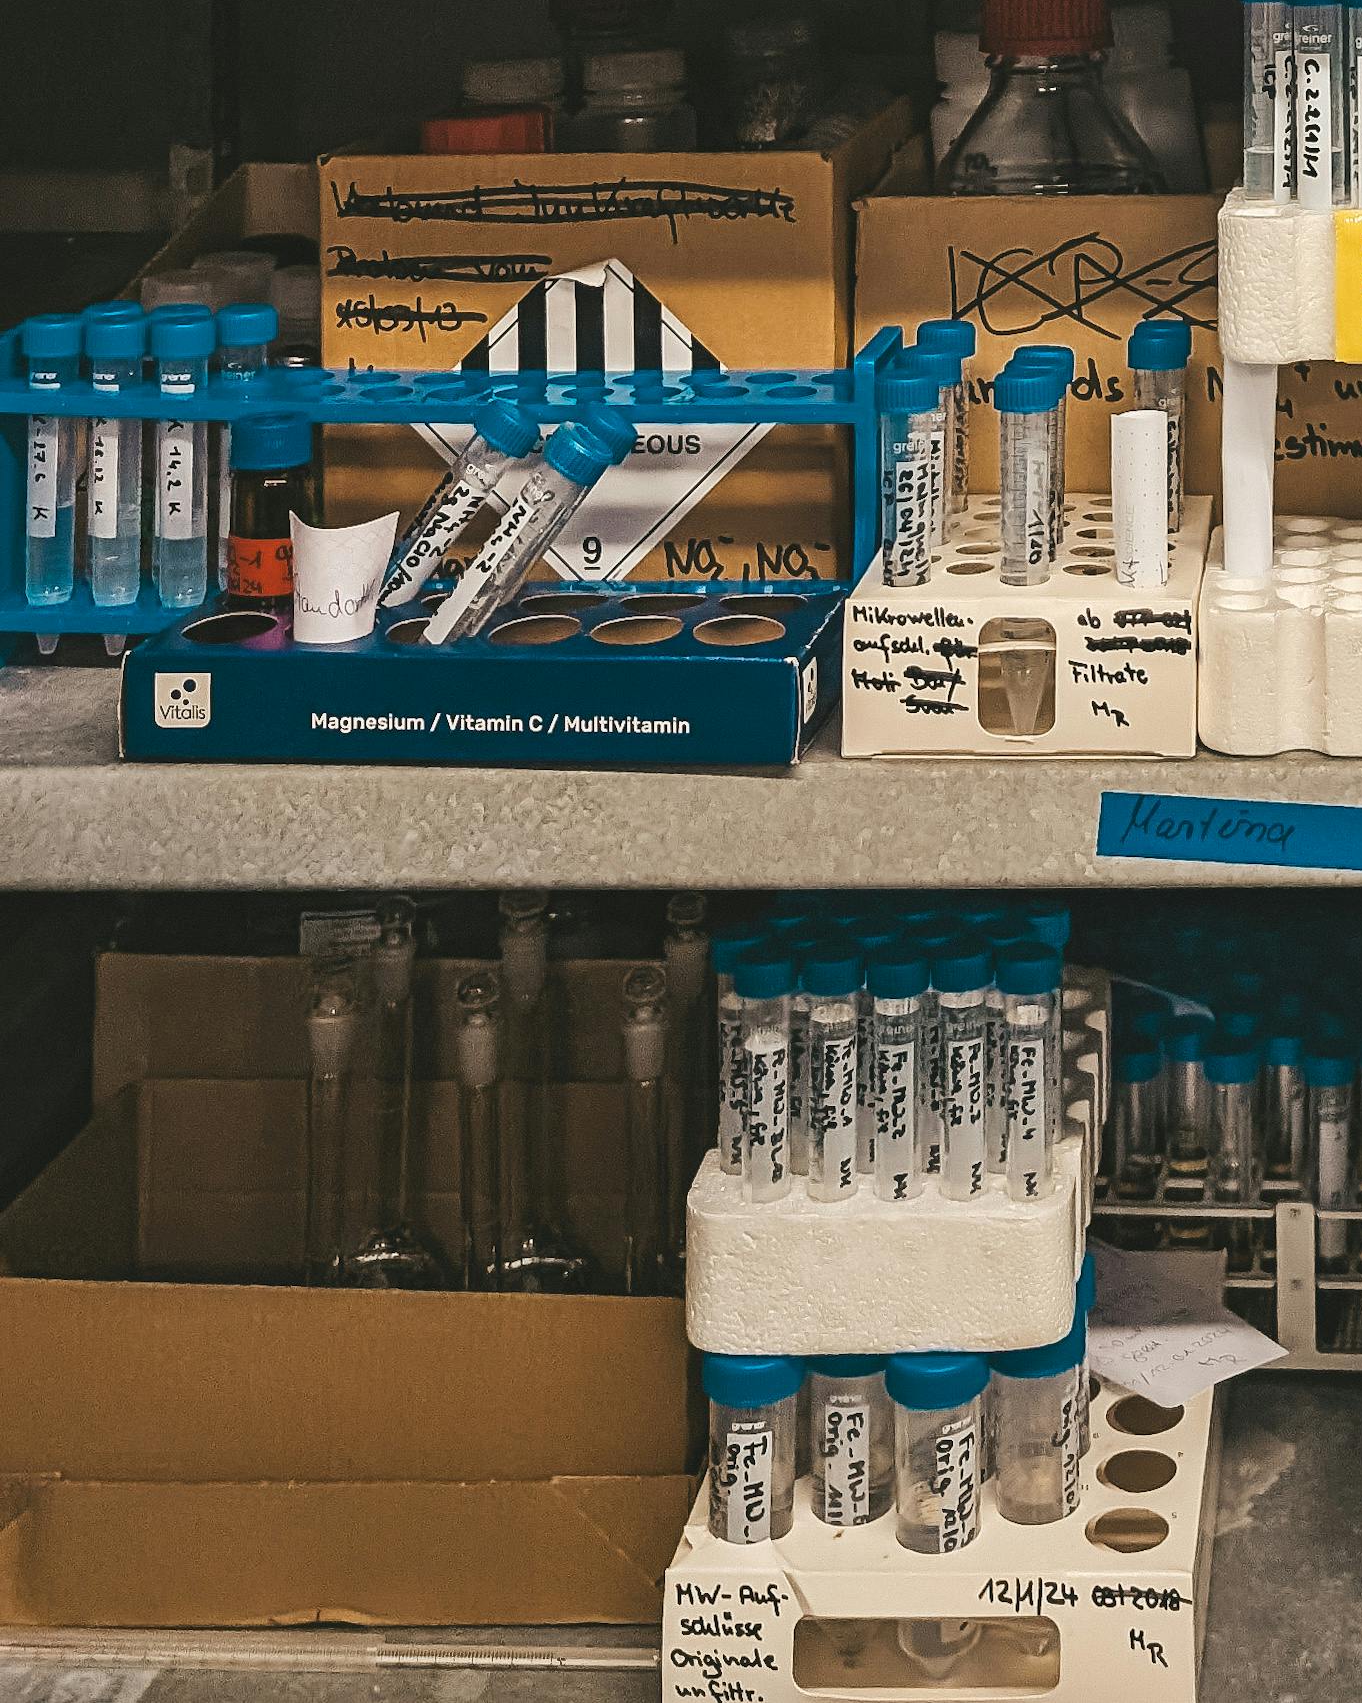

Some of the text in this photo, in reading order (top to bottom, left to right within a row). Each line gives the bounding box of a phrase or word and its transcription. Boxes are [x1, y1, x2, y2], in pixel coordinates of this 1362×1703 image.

[582, 536, 602, 565] 9
[1077, 608, 1101, 629] ab
[1068, 660, 1149, 685] Filtrate
[158, 703, 207, 721] Vitalis
[310, 711, 691, 735] Magnesium / Vitamin C / Multivitamin
[1120, 793, 1296, 851] Martina
[680, 1611, 764, 1642] schlüsse
[670, 1647, 779, 1680] Originale
